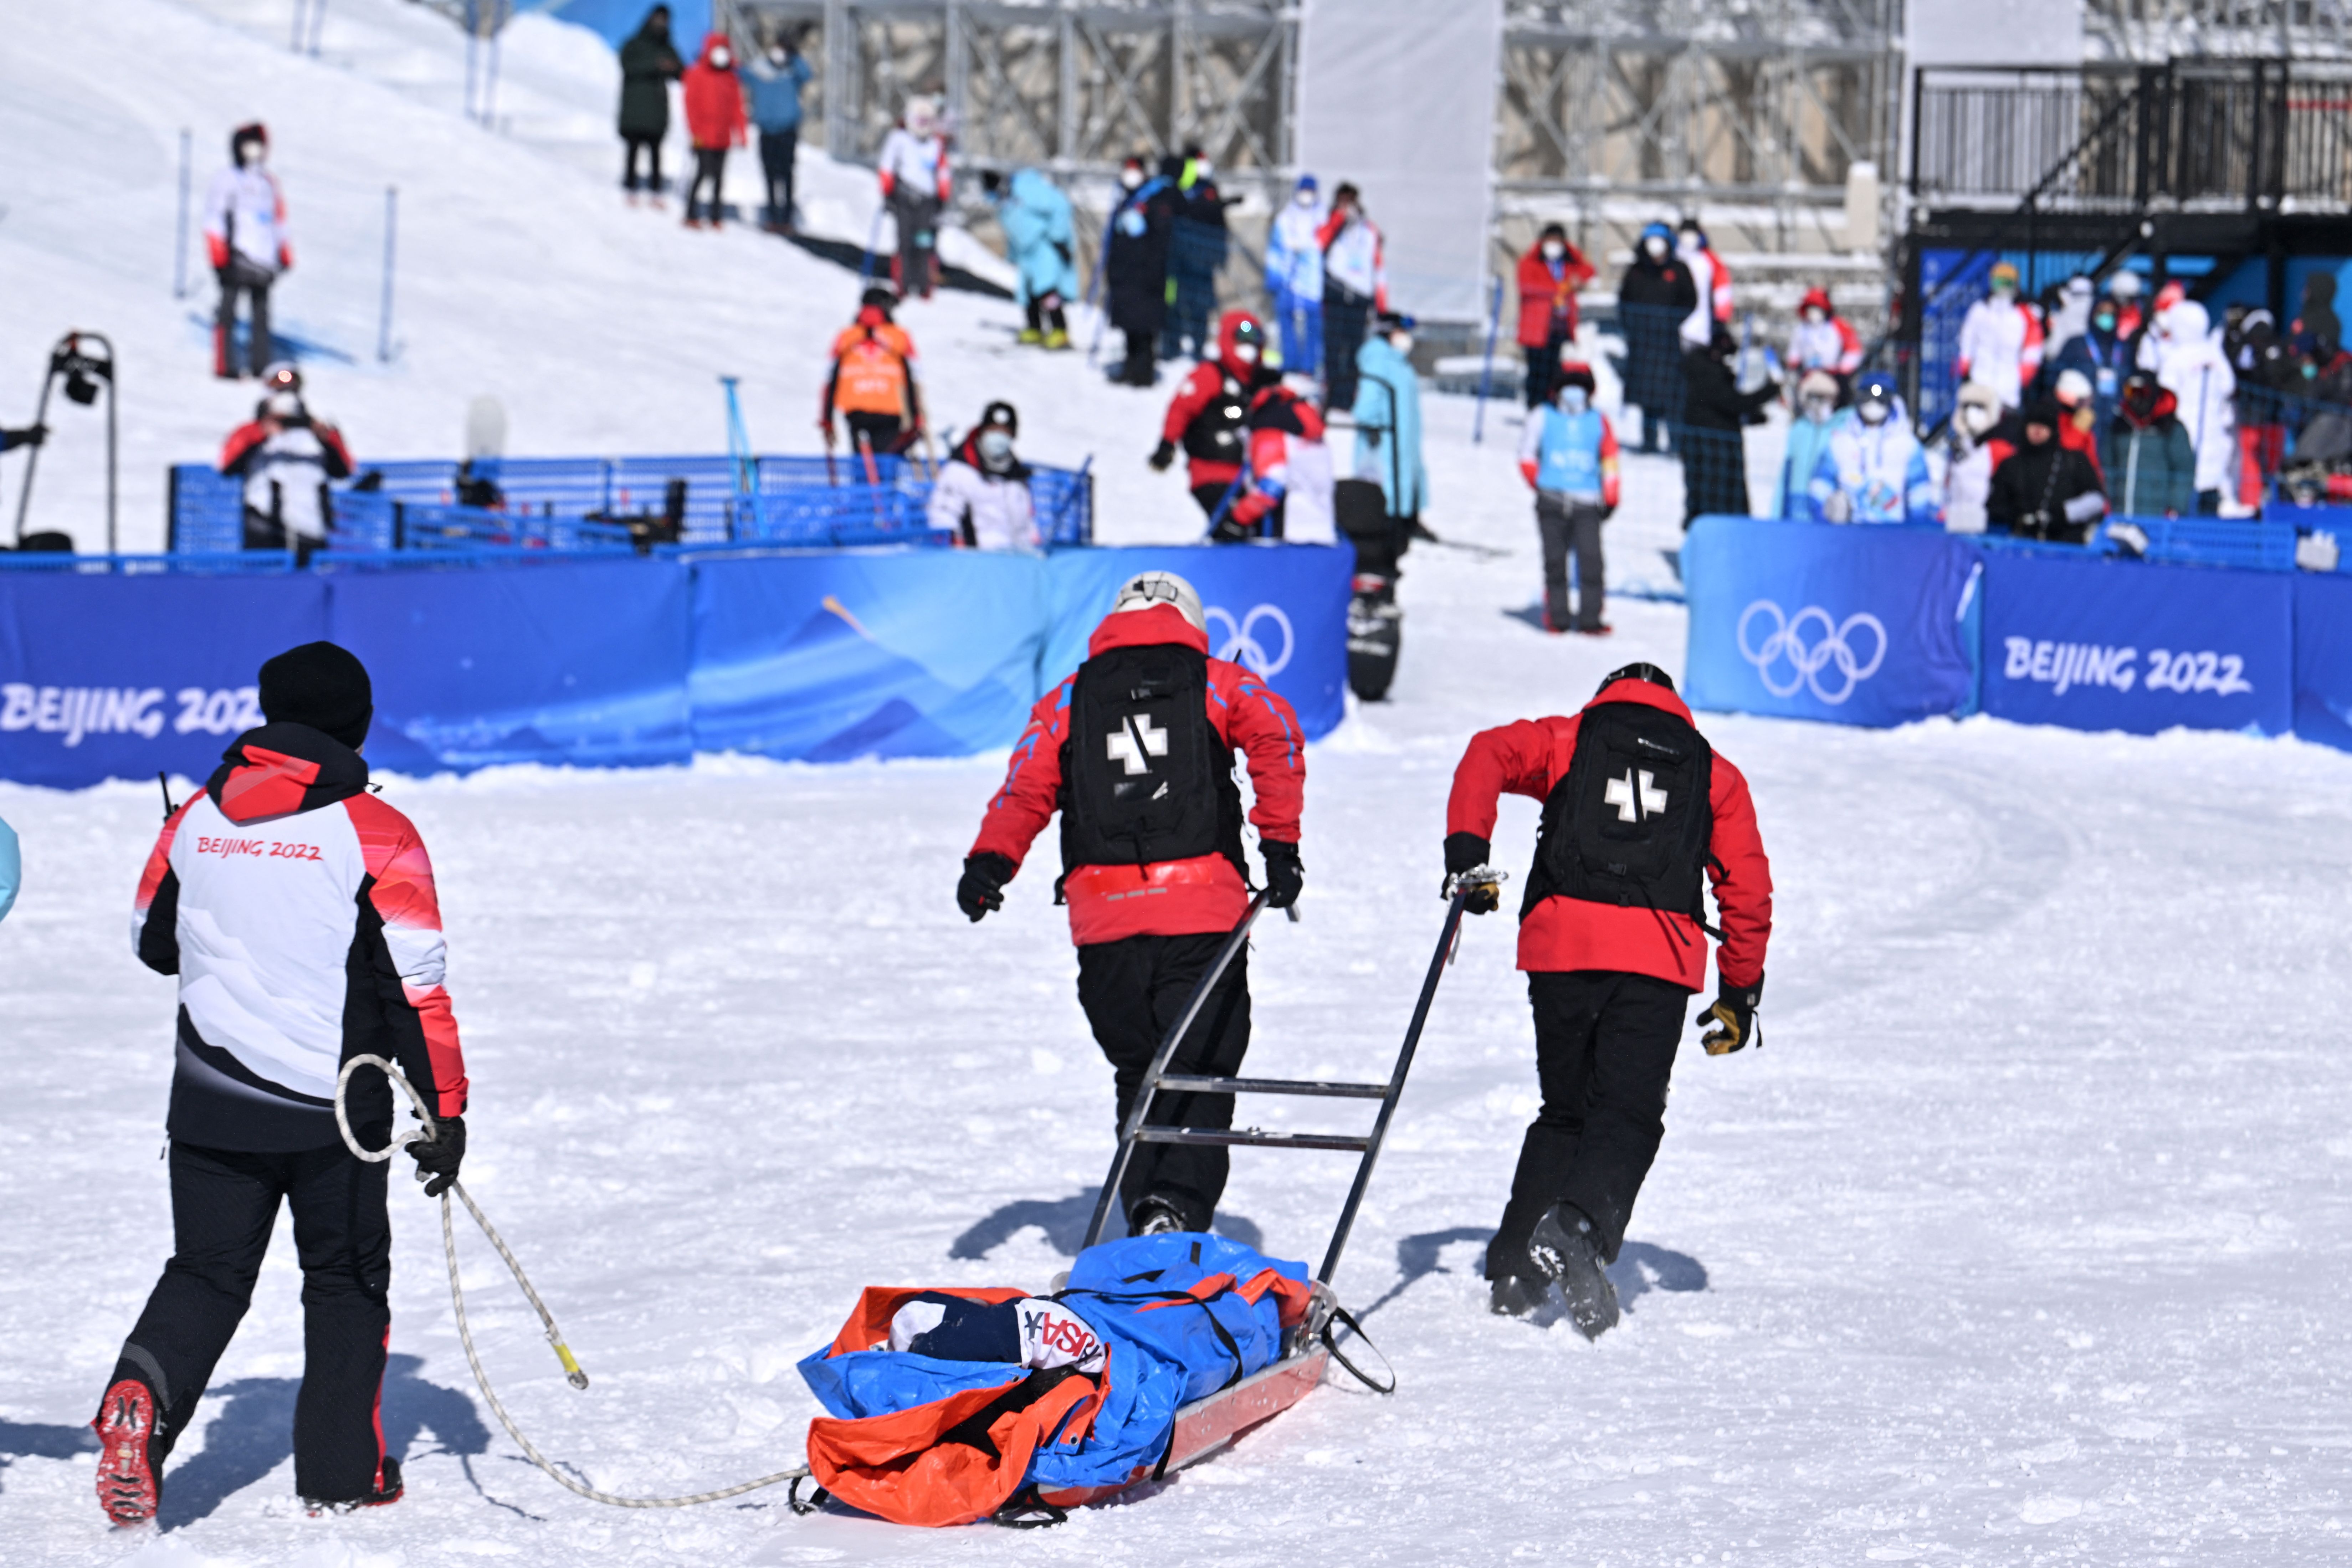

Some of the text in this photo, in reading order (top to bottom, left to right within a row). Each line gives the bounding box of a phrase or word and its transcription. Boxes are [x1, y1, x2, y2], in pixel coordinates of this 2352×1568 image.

[2004, 636, 2253, 696] BEIJING 2022
[1, 683, 266, 747] BEIJING 202
[198, 837, 323, 860] BEIJING 2022
